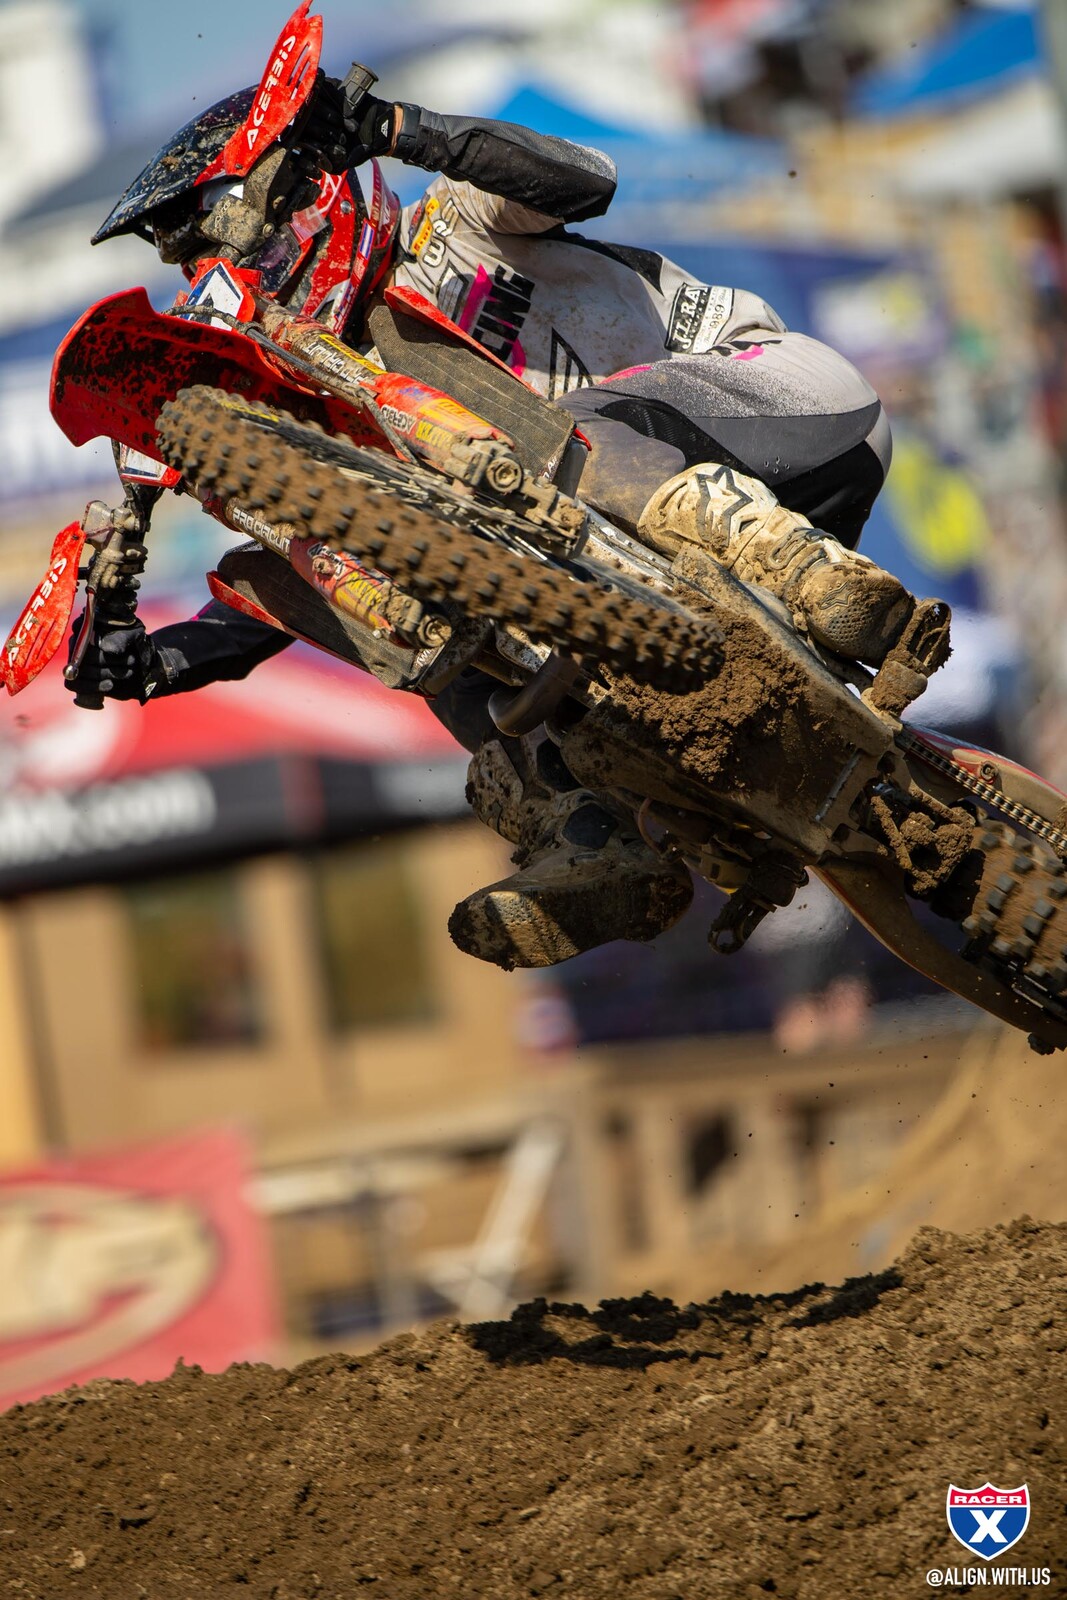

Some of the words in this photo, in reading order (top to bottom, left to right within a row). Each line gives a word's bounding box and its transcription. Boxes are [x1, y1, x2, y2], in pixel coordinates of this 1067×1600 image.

[232, 508, 254, 531] PRO
[253, 518, 290, 553] CIRCUIT
[415, 648, 432, 667] TWI
